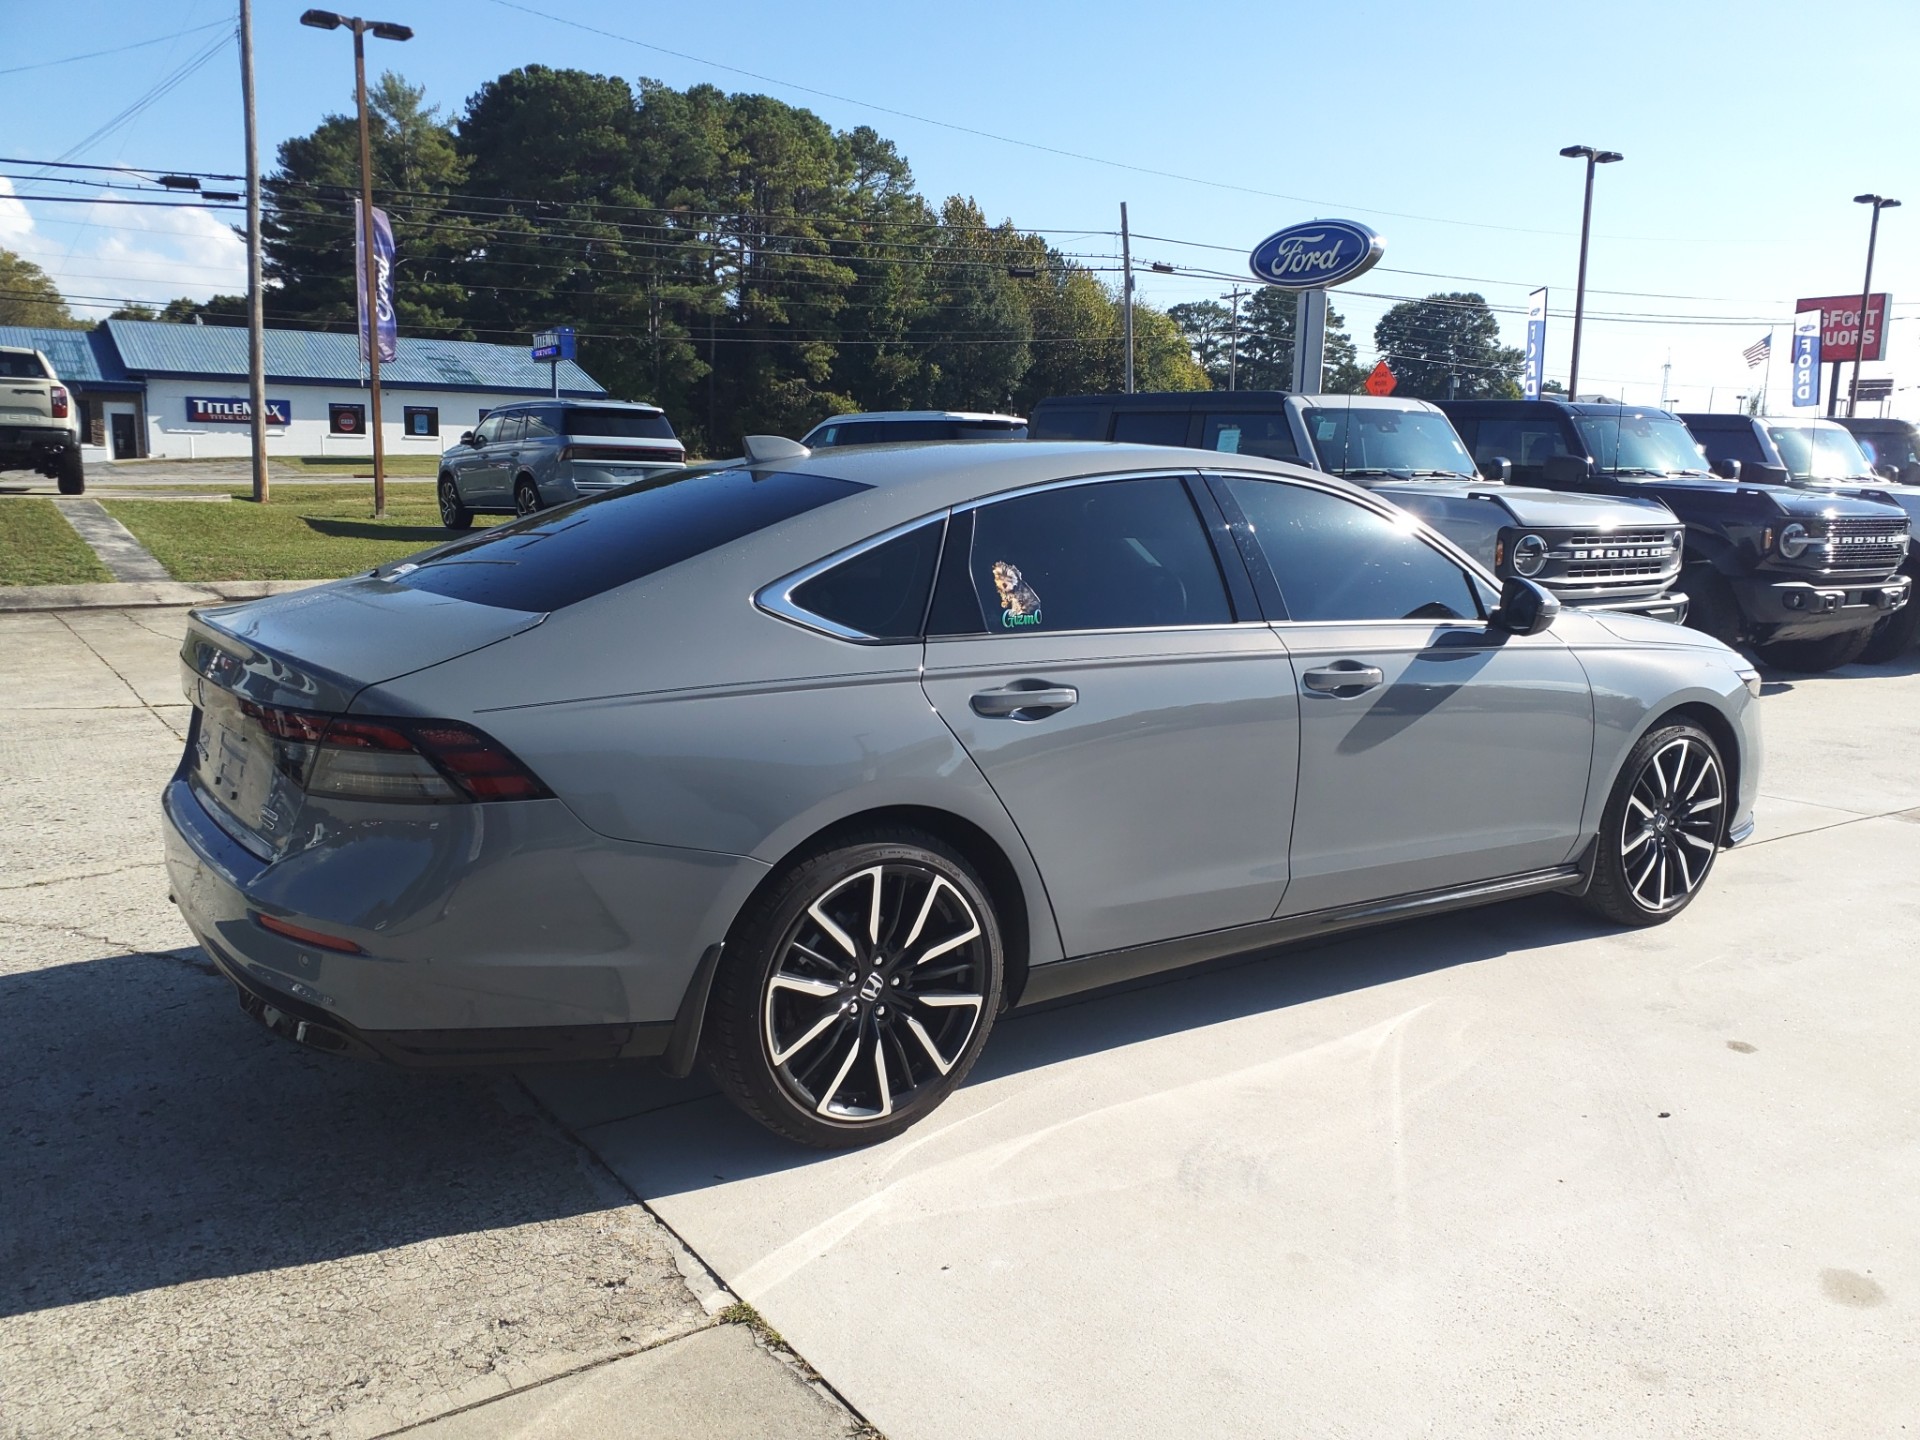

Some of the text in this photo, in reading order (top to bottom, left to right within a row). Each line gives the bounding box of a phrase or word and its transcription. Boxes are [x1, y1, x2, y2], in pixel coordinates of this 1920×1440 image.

[1271, 233, 1344, 276] Ford
[1821, 309, 1880, 328] GFOOT
[1821, 329, 1876, 347] UORS
[1830, 535, 1895, 545] BRONCO
[1573, 547, 1662, 560] BRONCO
